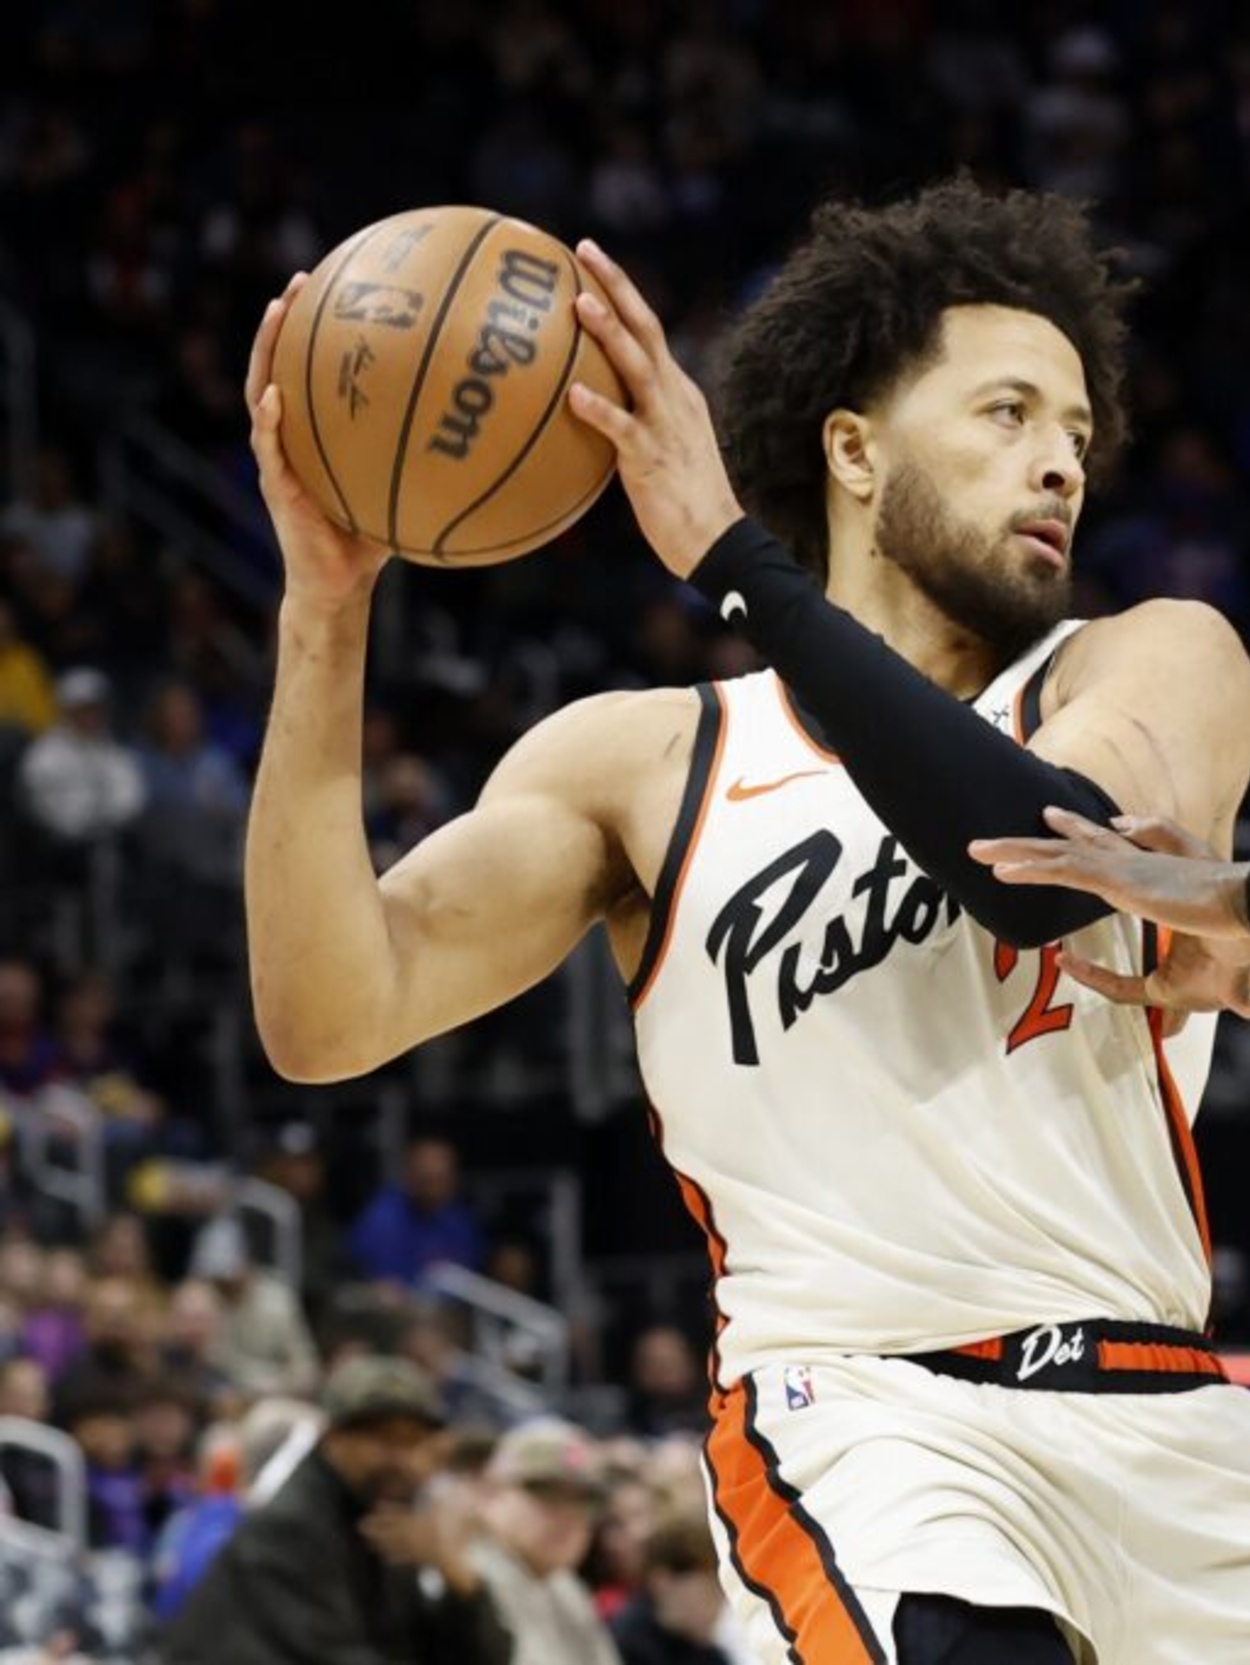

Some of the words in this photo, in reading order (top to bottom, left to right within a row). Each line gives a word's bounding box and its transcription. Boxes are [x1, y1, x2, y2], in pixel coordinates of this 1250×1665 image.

[430, 249, 560, 460] Wilson
[705, 828, 963, 1067] Pisto
[993, 942, 1073, 1056] 2
[1016, 1323, 1084, 1381] Det
